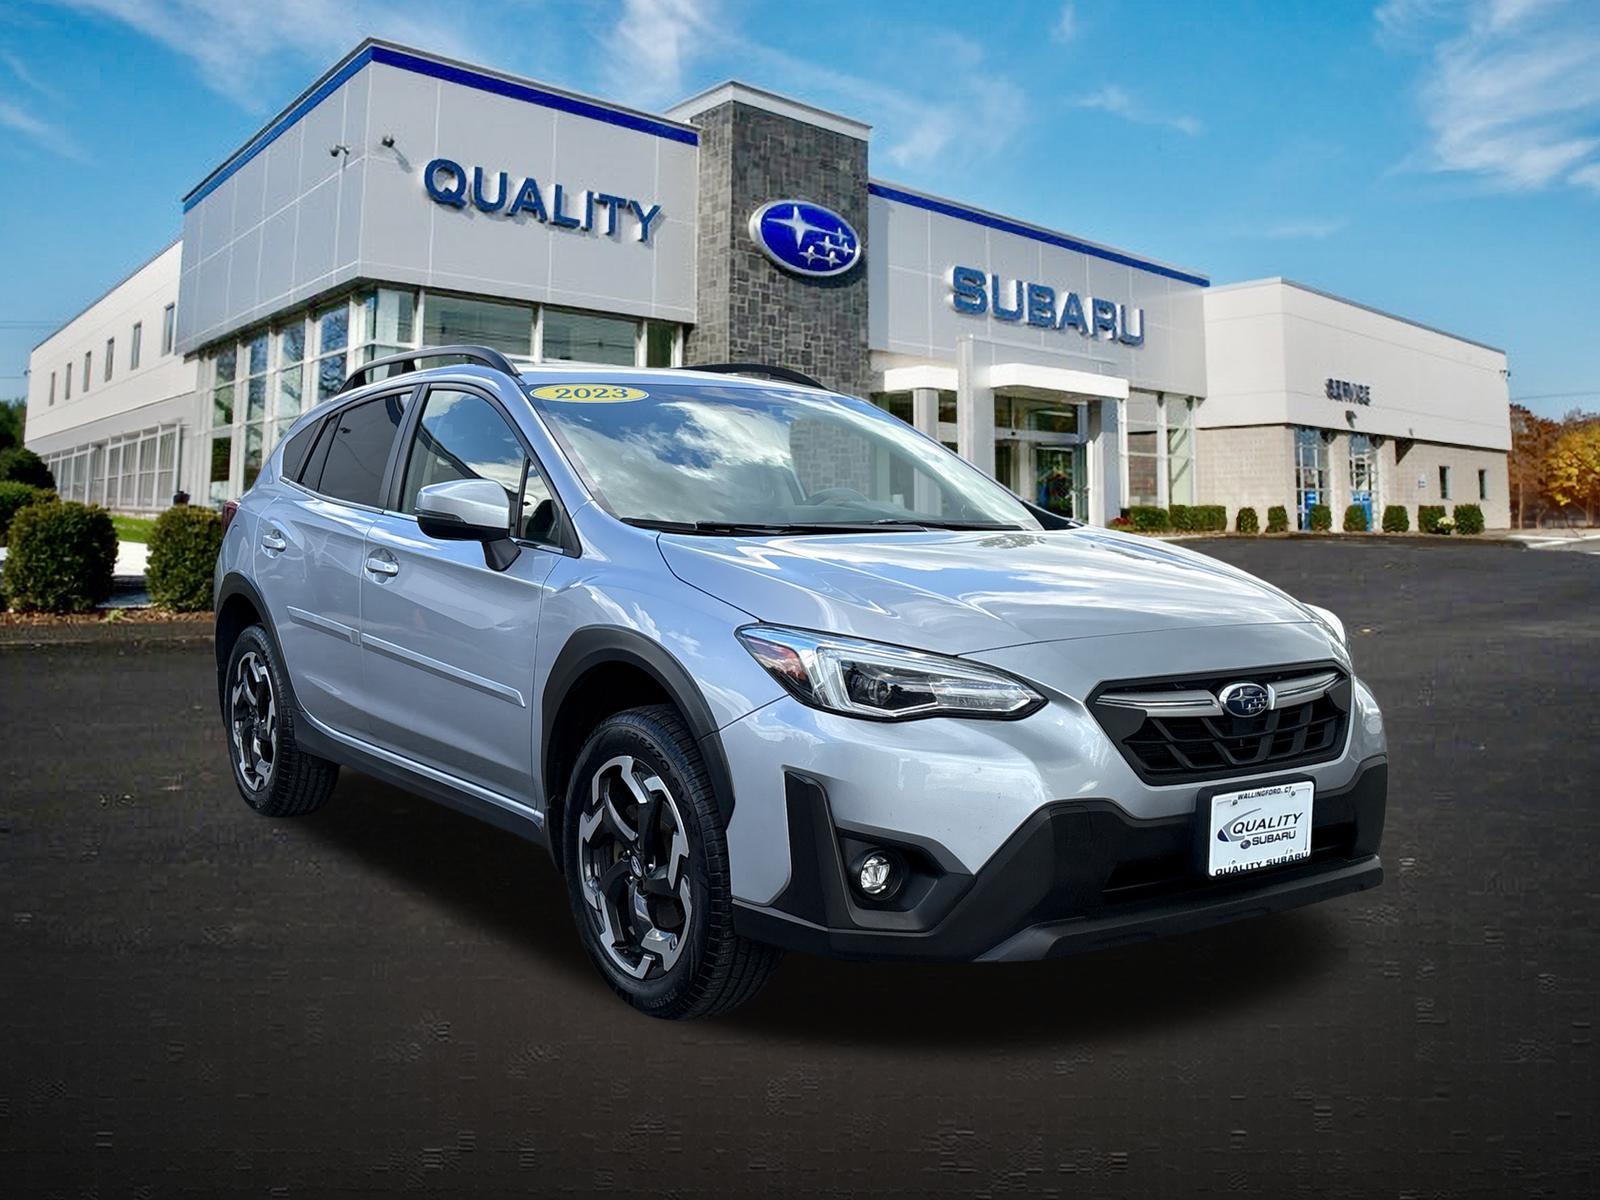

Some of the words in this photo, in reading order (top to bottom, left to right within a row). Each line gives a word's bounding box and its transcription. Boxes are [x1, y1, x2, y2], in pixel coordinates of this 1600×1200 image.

[424, 158, 662, 243] QUALITY
[950, 265, 1145, 346] SUBARU
[555, 387, 629, 399] 2023
[1233, 812, 1303, 834] QUALITY
[1252, 830, 1296, 846] SUBARU
[1215, 860, 1263, 876] QUALITY
[1266, 851, 1308, 867] SUBARU
